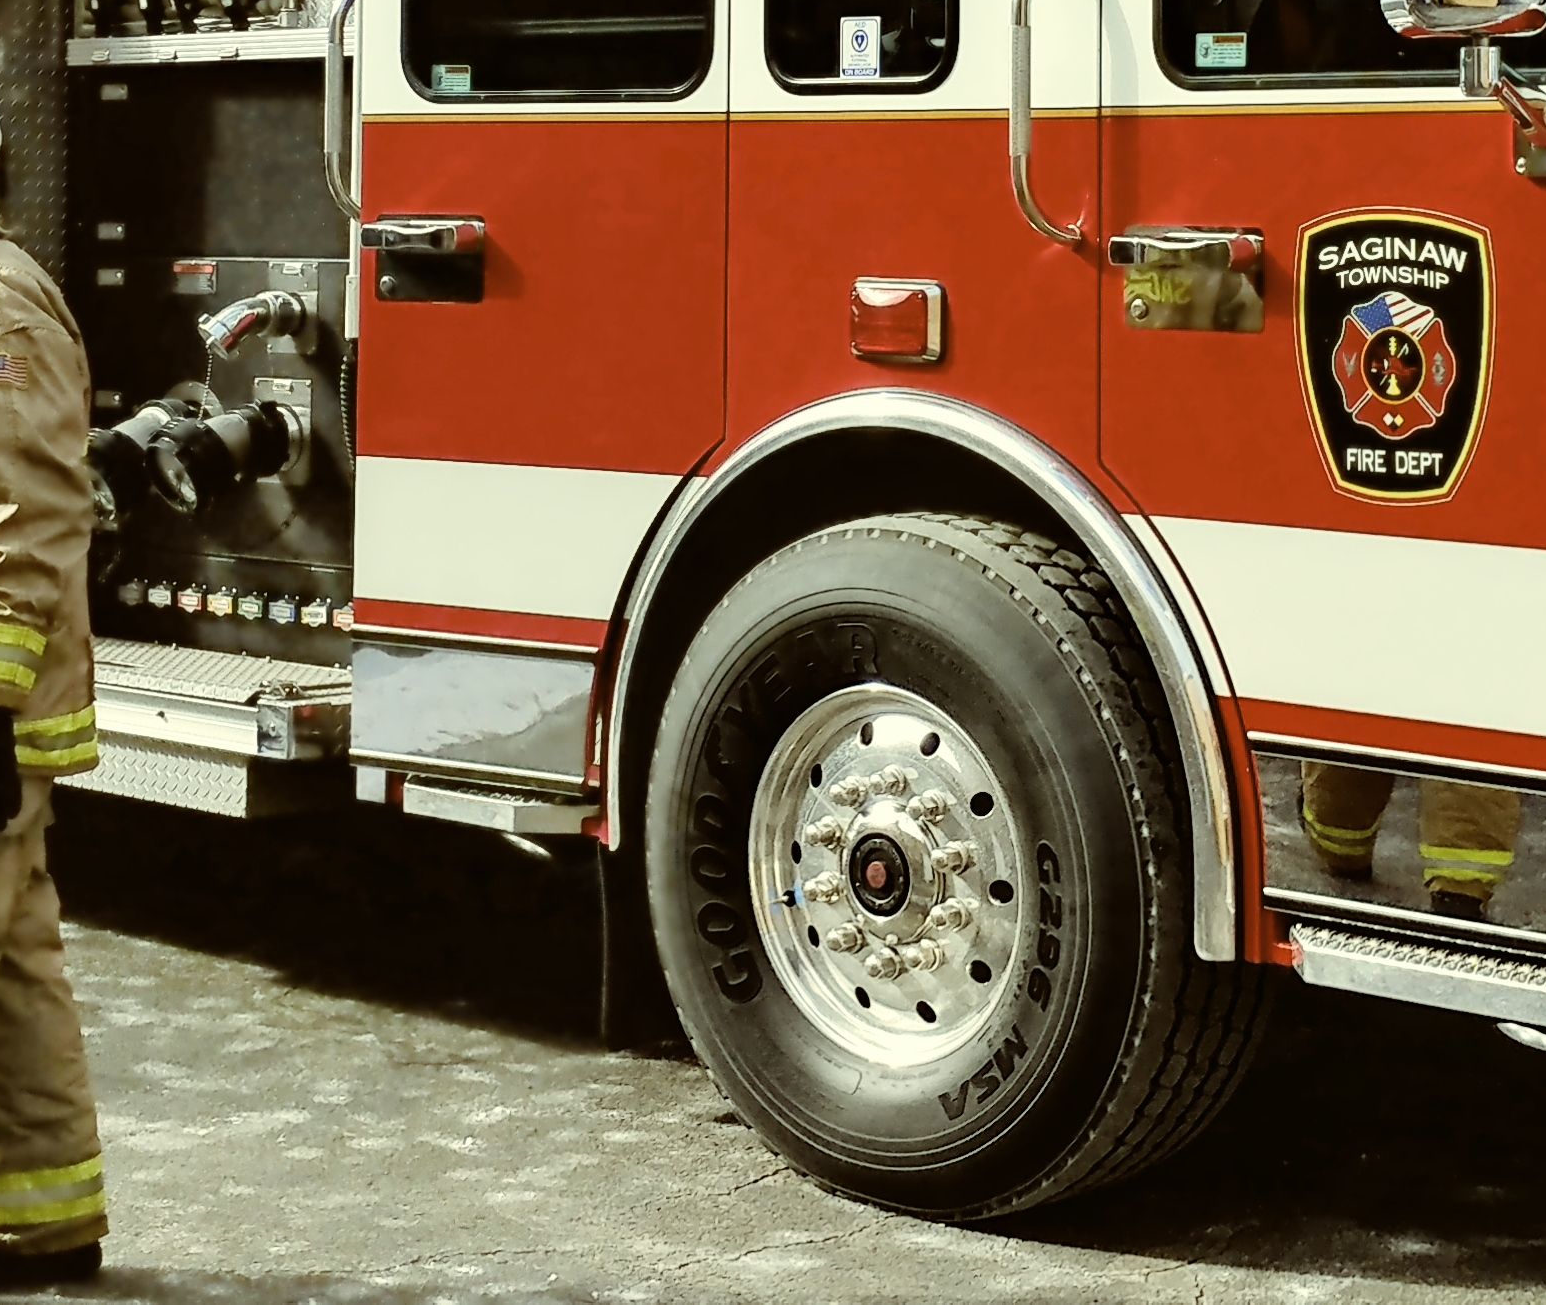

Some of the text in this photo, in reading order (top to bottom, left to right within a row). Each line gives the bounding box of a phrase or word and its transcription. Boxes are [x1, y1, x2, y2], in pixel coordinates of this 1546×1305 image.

[1318, 236, 1468, 273] SAGINAW
[1336, 265, 1450, 290] TOWNSHIP
[1346, 448, 1444, 476] FIRE DEPT
[938, 1021, 1029, 1121] MSA
